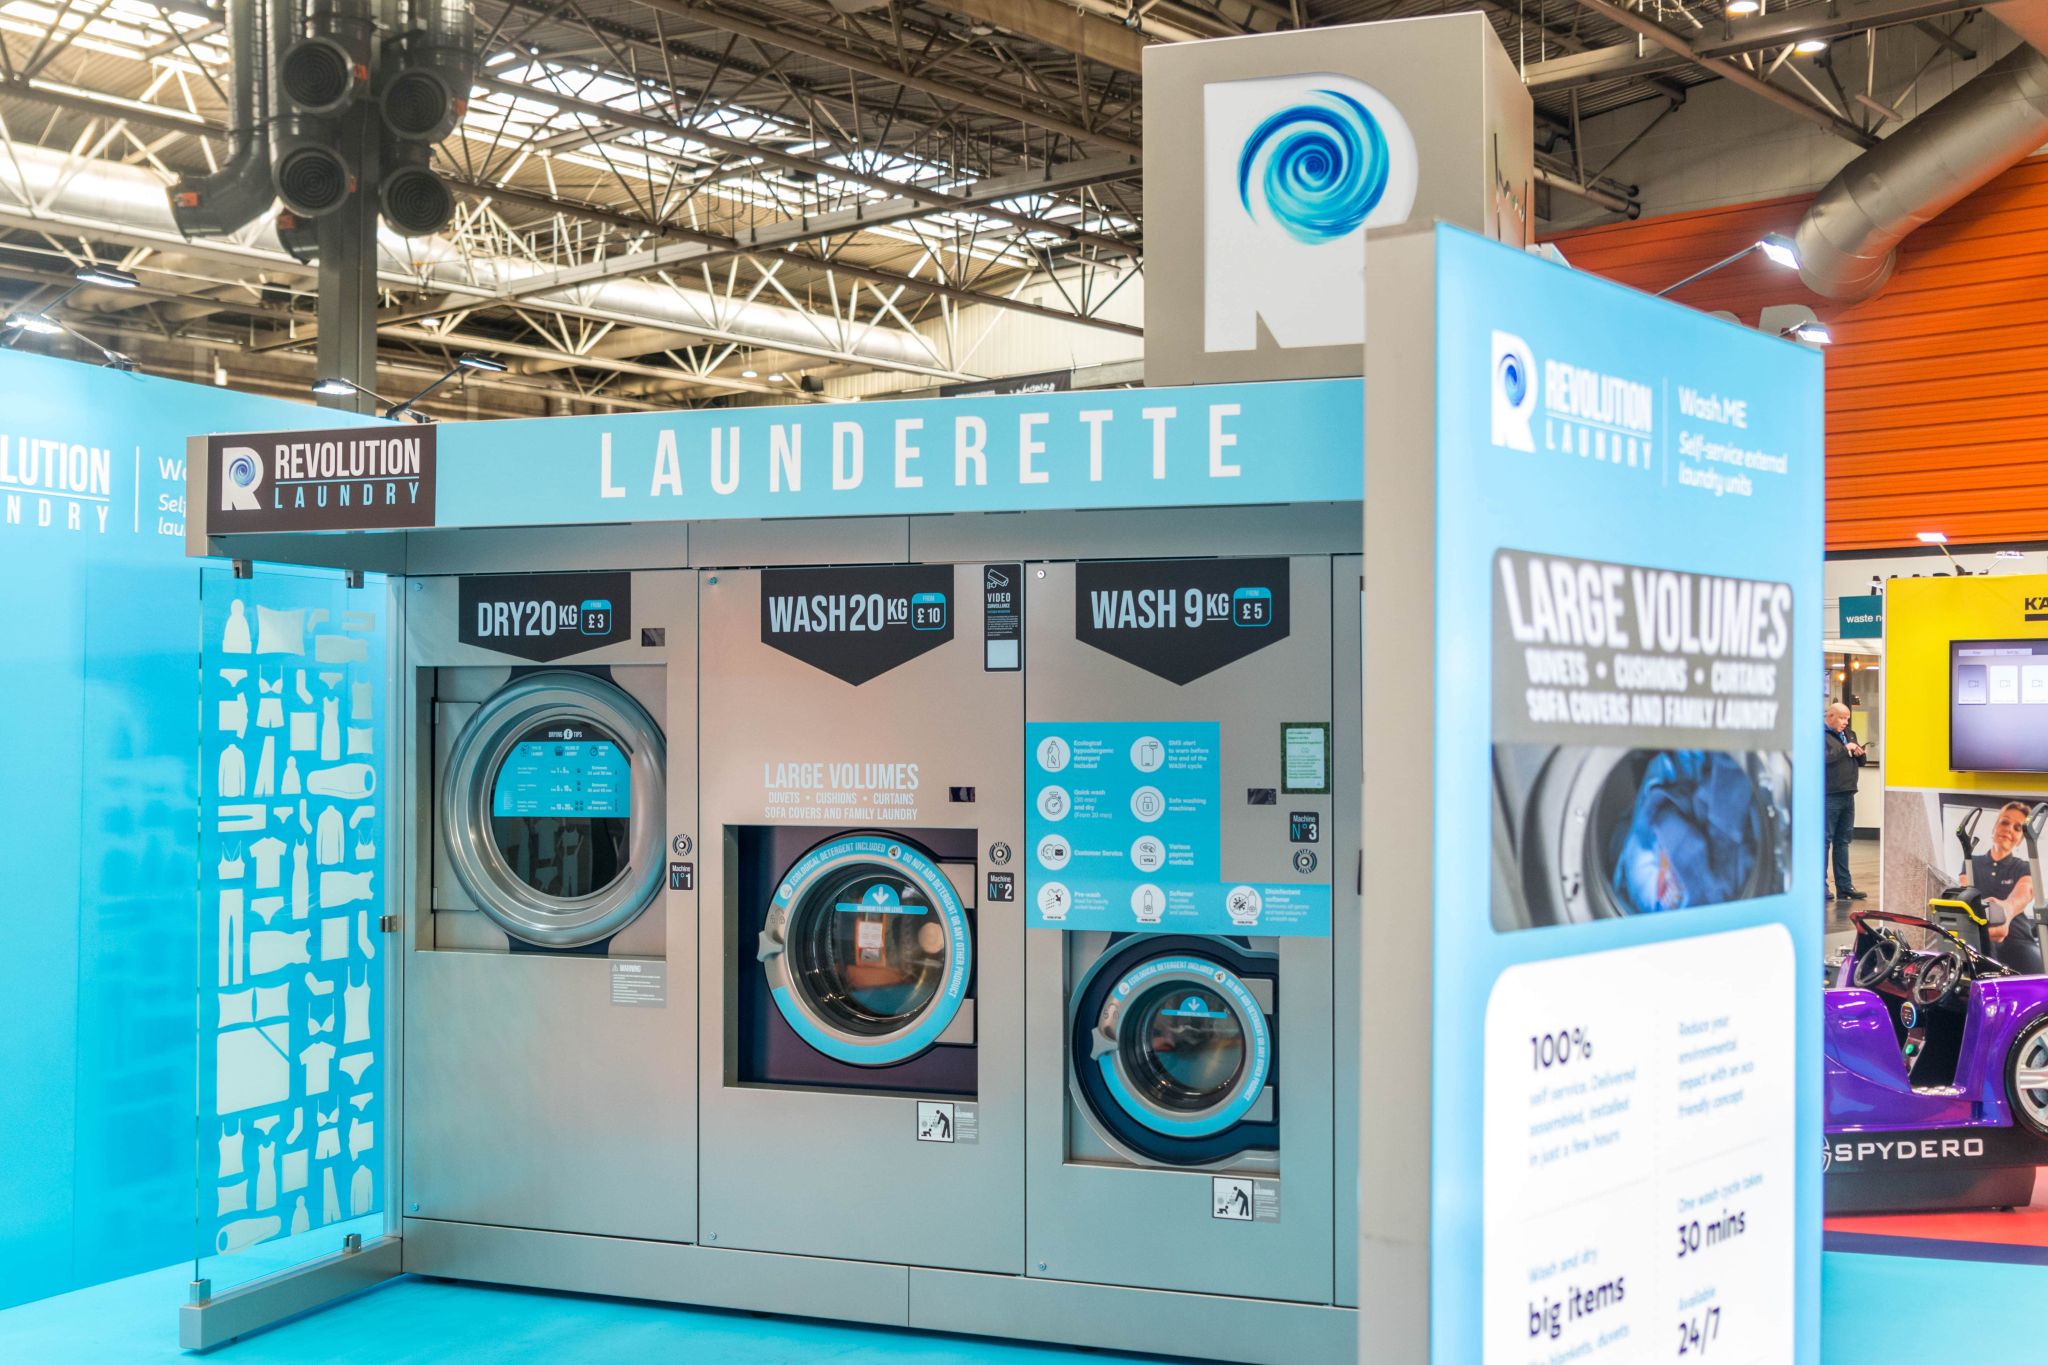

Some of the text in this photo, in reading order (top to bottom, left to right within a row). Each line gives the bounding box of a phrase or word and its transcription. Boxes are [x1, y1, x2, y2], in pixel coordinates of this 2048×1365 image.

[1545, 358, 1653, 433] REVOLUTION
[276, 438, 420, 480] REVOLUTION
[600, 403, 1242, 499] LAUNDERETTE
[1546, 420, 1652, 470] LAUNDRY
[1679, 431, 1788, 474] Self-service external
[275, 482, 420, 509] LAUNDRY
[1678, 460, 1752, 496] laundry units
[7, 495, 109, 534] NDRY
[987, 592, 1011, 602] VIDEO
[1091, 589, 1176, 629] WASH
[1499, 555, 1791, 659] LARGE VOLUMES
[1846, 614, 1873, 623] waste
[1525, 649, 1776, 696] DUVETS CUSHIONS CURTAINS
[1526, 689, 1778, 730] SOFA COVERS AND FAMILY LAUNDRY
[764, 762, 919, 790] LARGE VOLUMES
[764, 807, 918, 820] SOFA COVERS AND FAMILY LAUNDRY
[768, 791, 914, 805] DUVETS CUSHIONS CURTAINS
[820, 842, 854, 861] DETERGENT
[855, 842, 886, 853] INCLUDED
[990, 874, 1011, 882] Machine
[1530, 1025, 1592, 1071] 100%
[1835, 1138, 1984, 1162] SPYDERO
[1677, 1208, 1745, 1258] 30 mins
[1529, 1277, 1624, 1339] big items
[1678, 1306, 1720, 1356] 24/7
